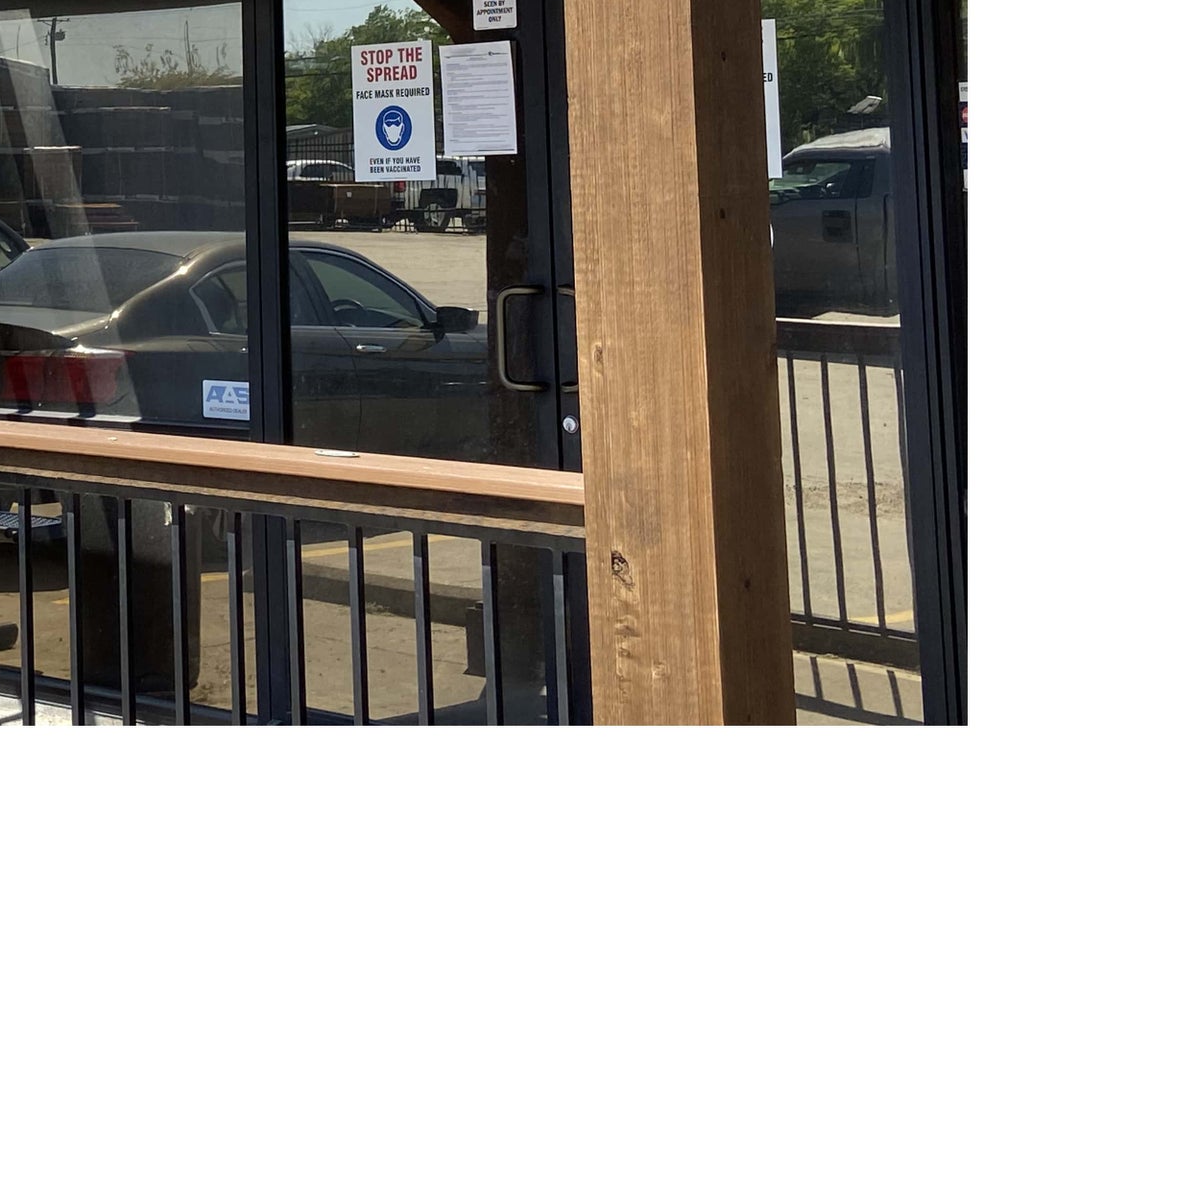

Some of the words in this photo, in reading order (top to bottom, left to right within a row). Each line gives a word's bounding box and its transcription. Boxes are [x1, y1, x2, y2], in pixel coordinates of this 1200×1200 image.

[476, 7, 513, 15] APPOINTMENT
[360, 49, 393, 65] STOP
[397, 47, 423, 63] THE
[367, 65, 417, 82] SPREAD
[356, 90, 373, 99] FACE
[374, 89, 394, 99] MASK
[395, 87, 430, 98] REQUIRED
[385, 165, 421, 173] VACCINATED
